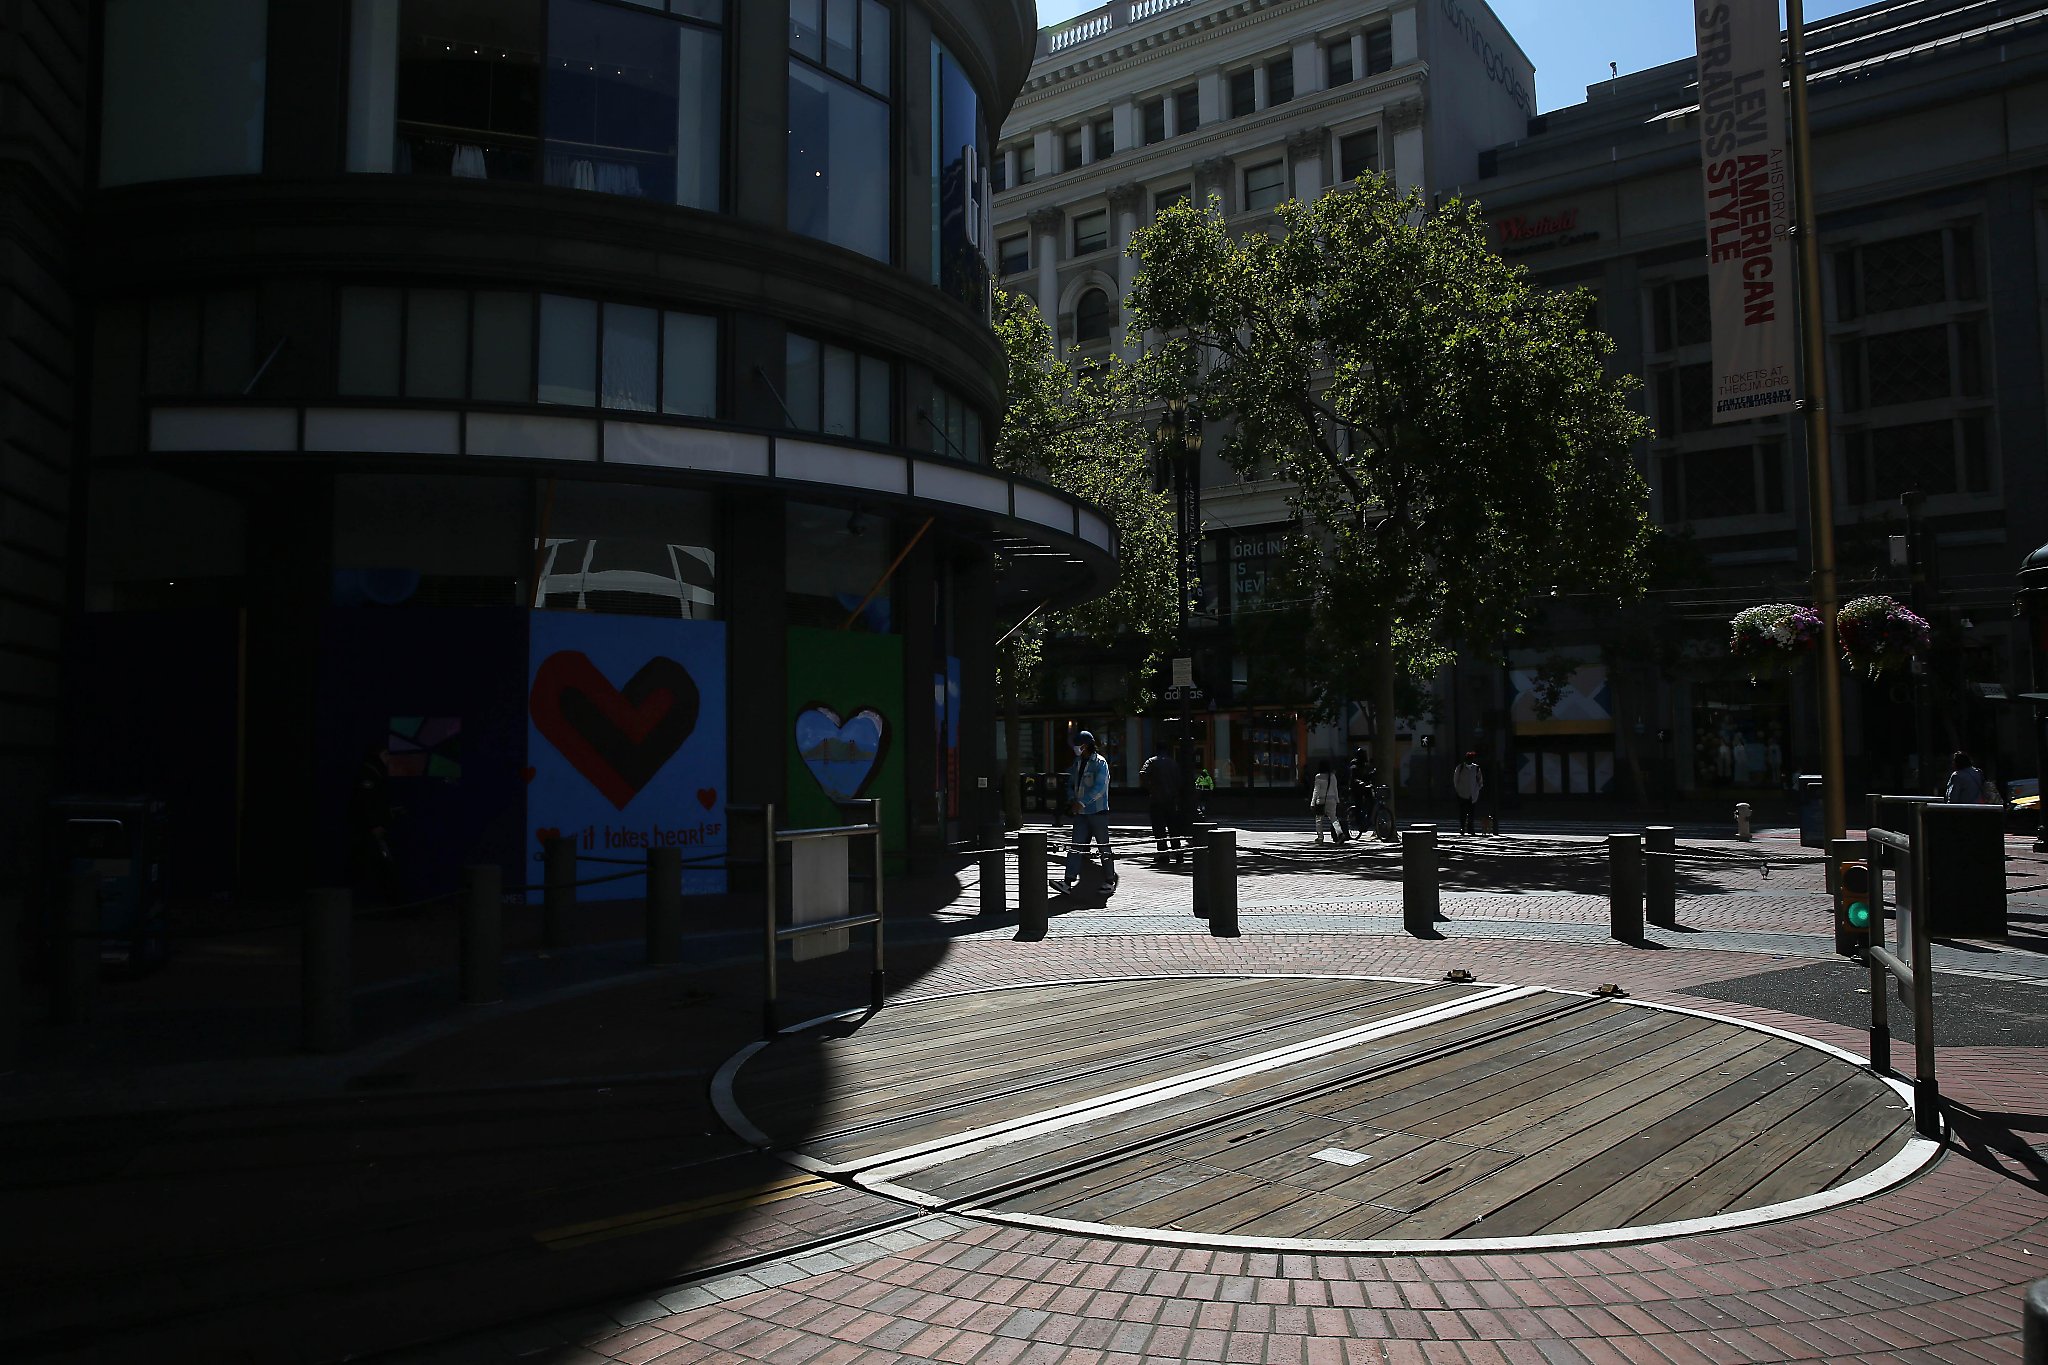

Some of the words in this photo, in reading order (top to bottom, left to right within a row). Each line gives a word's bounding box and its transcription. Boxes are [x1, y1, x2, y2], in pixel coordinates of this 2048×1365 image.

[1698, 3, 1737, 158] STRAUSS
[1733, 69, 1768, 148] LEVI
[1771, 148, 1783, 158] A
[1771, 162, 1786, 220] HISTORY
[1496, 208, 1579, 244] Westfield
[1707, 158, 1742, 264] STYLE
[1737, 154, 1775, 327] AMERICAN
[1773, 224, 1787, 243] OF
[1718, 375, 1790, 396] THECJM.ORG
[1722, 369, 1768, 385] TICKETS
[1770, 365, 1784, 377] AT
[1233, 540, 1284, 557] ORIGIN
[583, 825, 596, 850] it
[605, 825, 649, 849] takes
